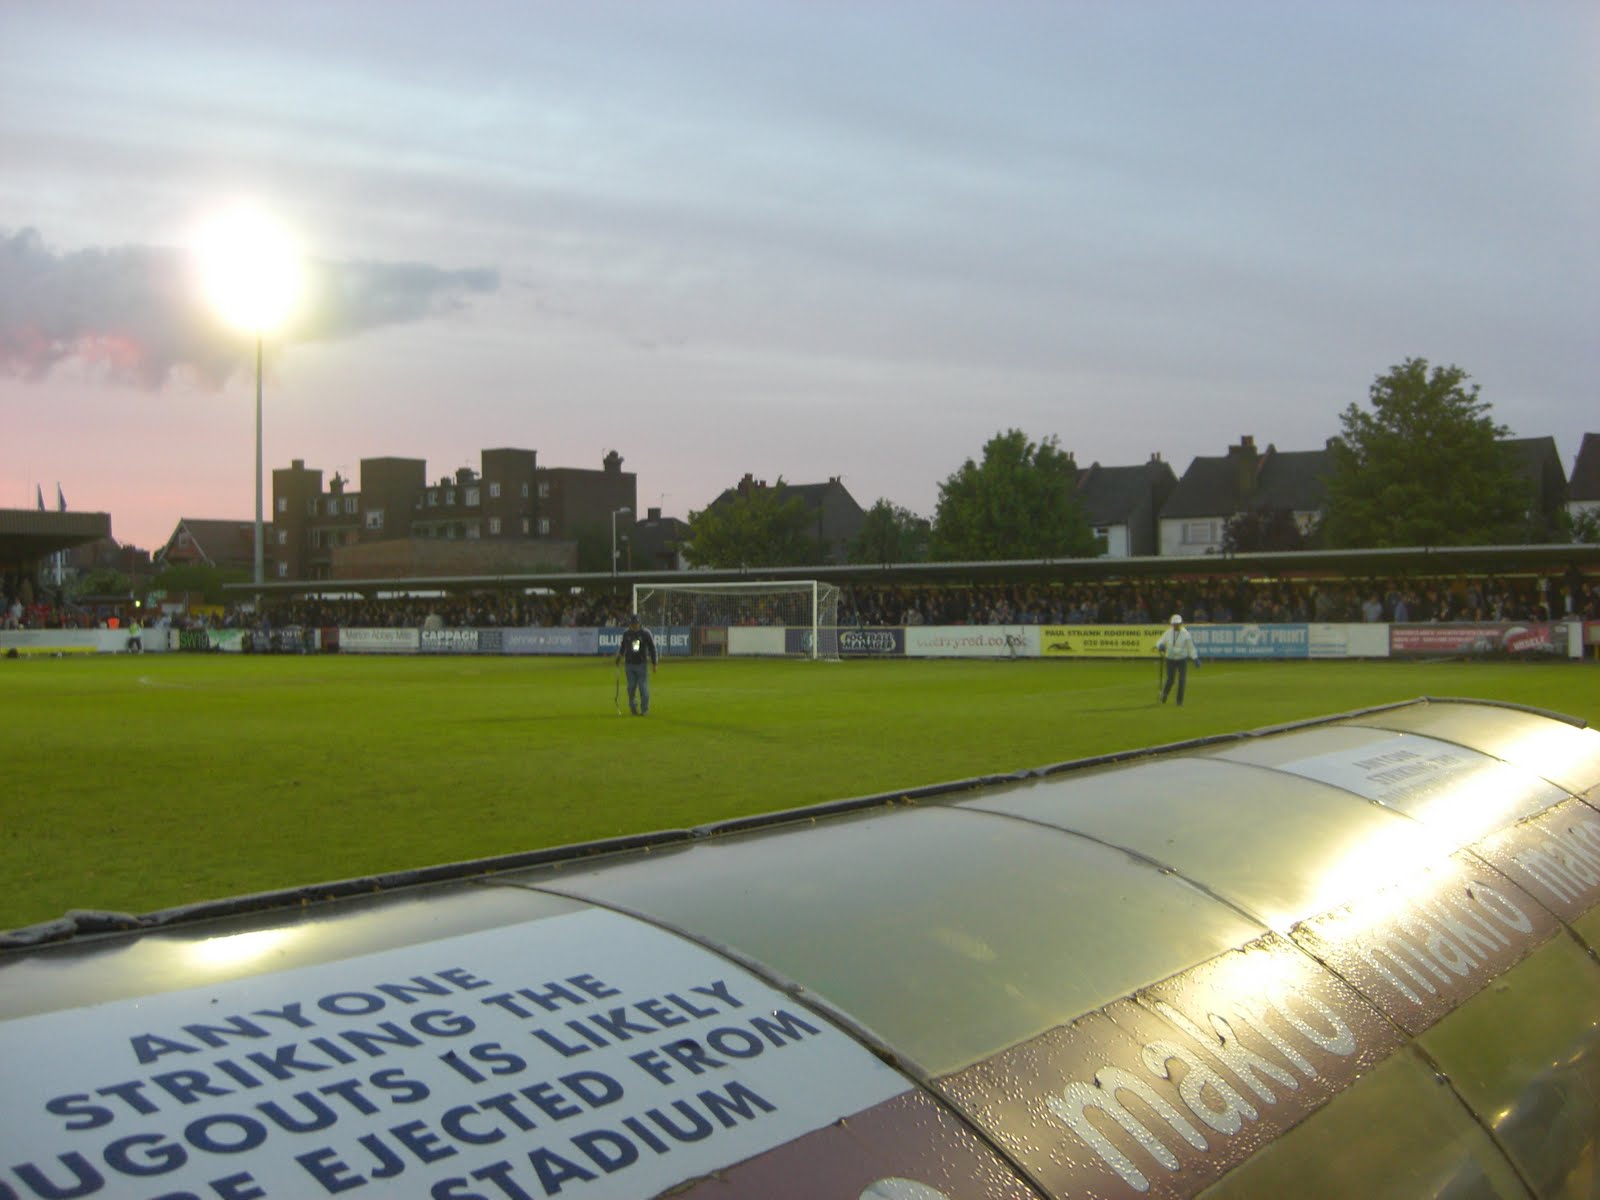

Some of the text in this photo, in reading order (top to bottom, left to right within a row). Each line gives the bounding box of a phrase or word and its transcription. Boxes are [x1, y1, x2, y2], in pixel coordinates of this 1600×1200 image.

[422, 631, 478, 640] CAPPAGH
[670, 635, 690, 646] BET
[843, 640, 893, 649] MANAGER
[1271, 630, 1306, 643] PRINT
[46, 974, 621, 1130] STRIKING THE
[130, 967, 493, 1065] ANYONE
[0, 980, 744, 1200] UGOUTS IS LIKELY
[148, 1009, 821, 1200] E EJECTED FROM
[1046, 980, 1357, 1192] makro
[430, 1081, 777, 1200] STADIUM
